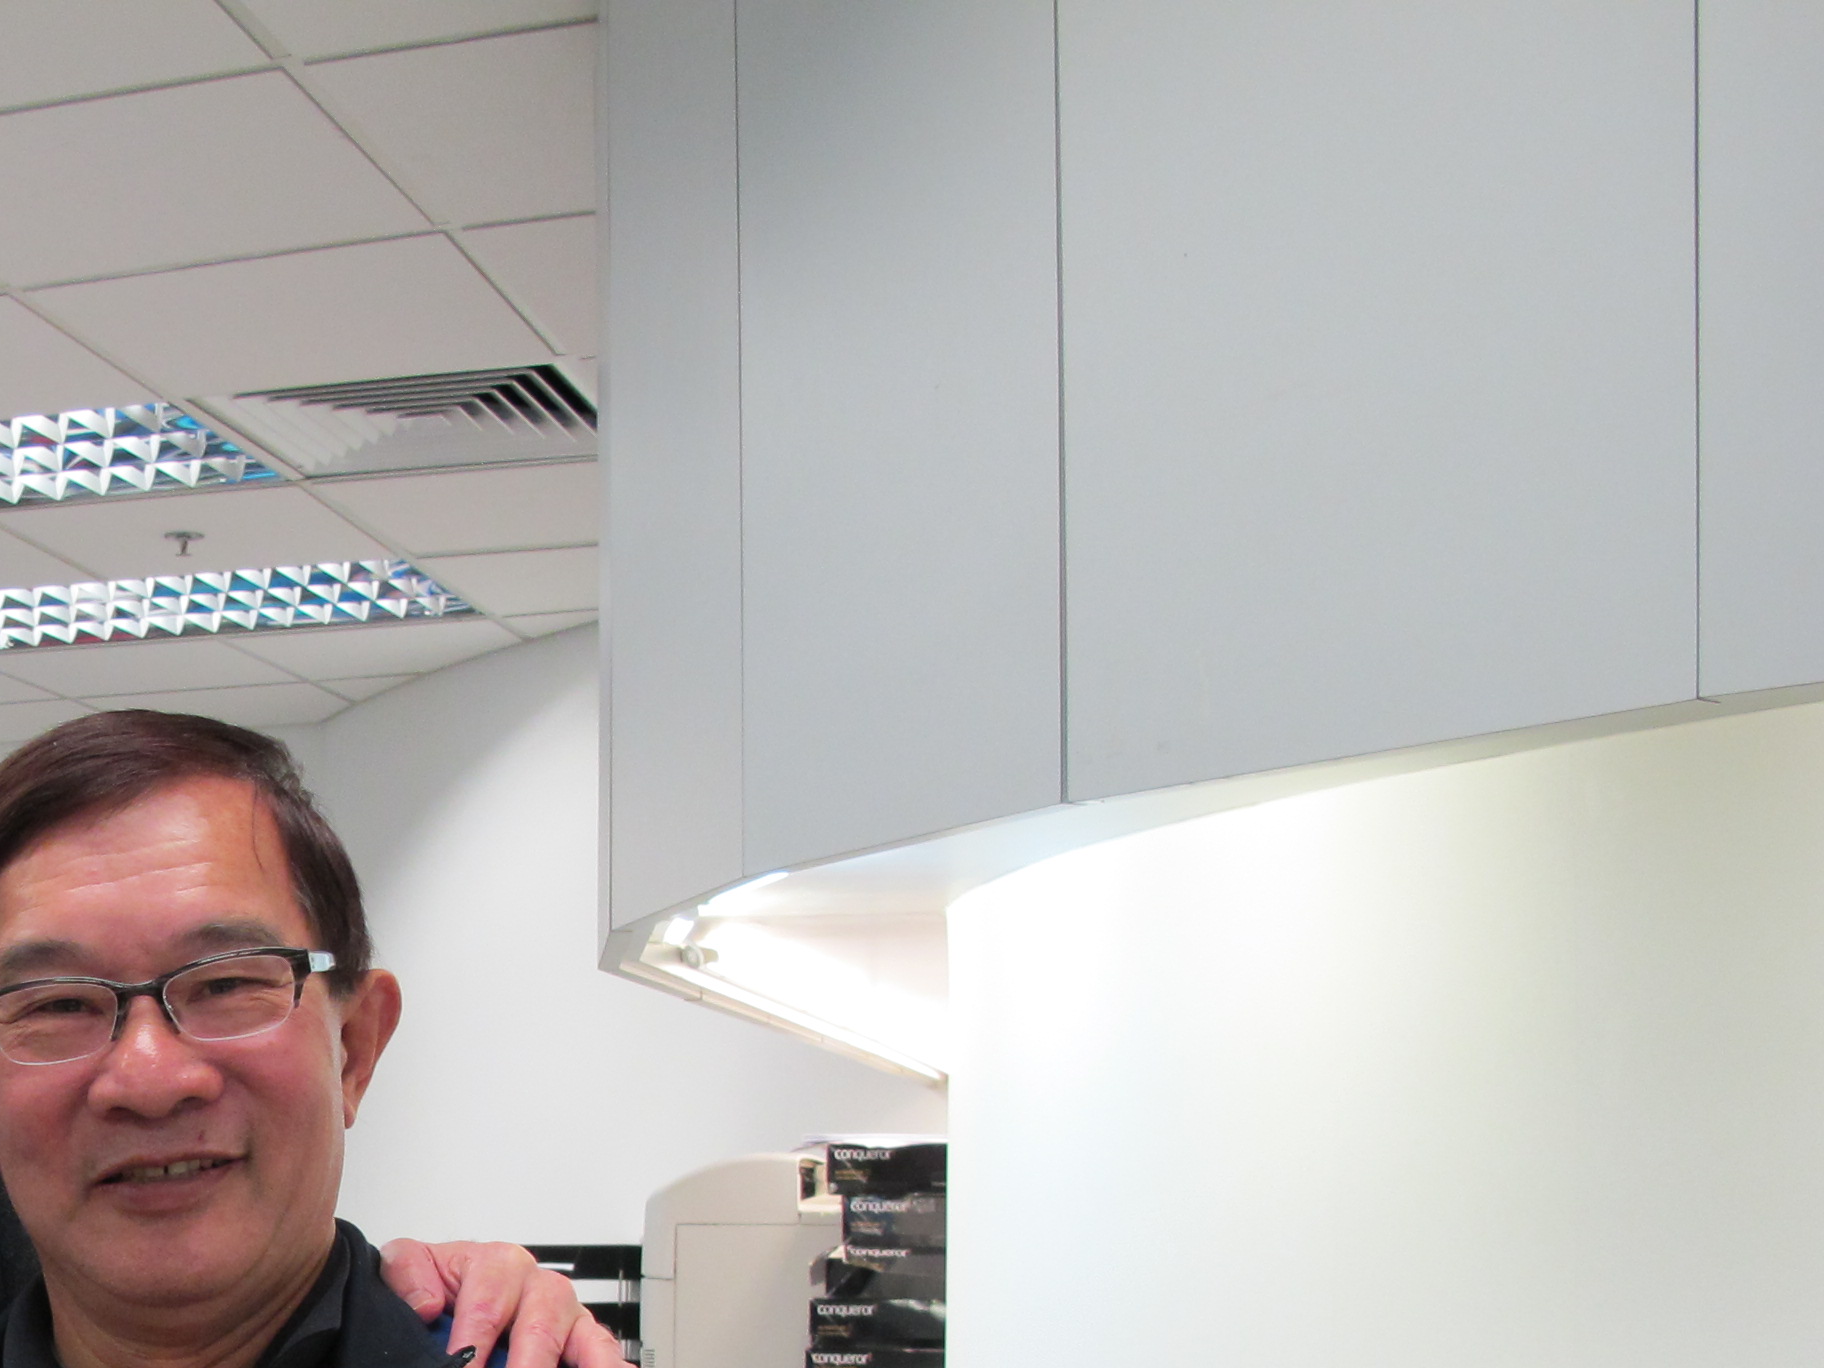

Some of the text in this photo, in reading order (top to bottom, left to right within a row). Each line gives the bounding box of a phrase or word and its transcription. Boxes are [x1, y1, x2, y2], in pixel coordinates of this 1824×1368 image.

[834, 1149, 892, 1161] conqueror
[850, 1200, 908, 1213] conqueror
[817, 1304, 874, 1317] conqueror
[811, 1353, 868, 1366] conqueror
